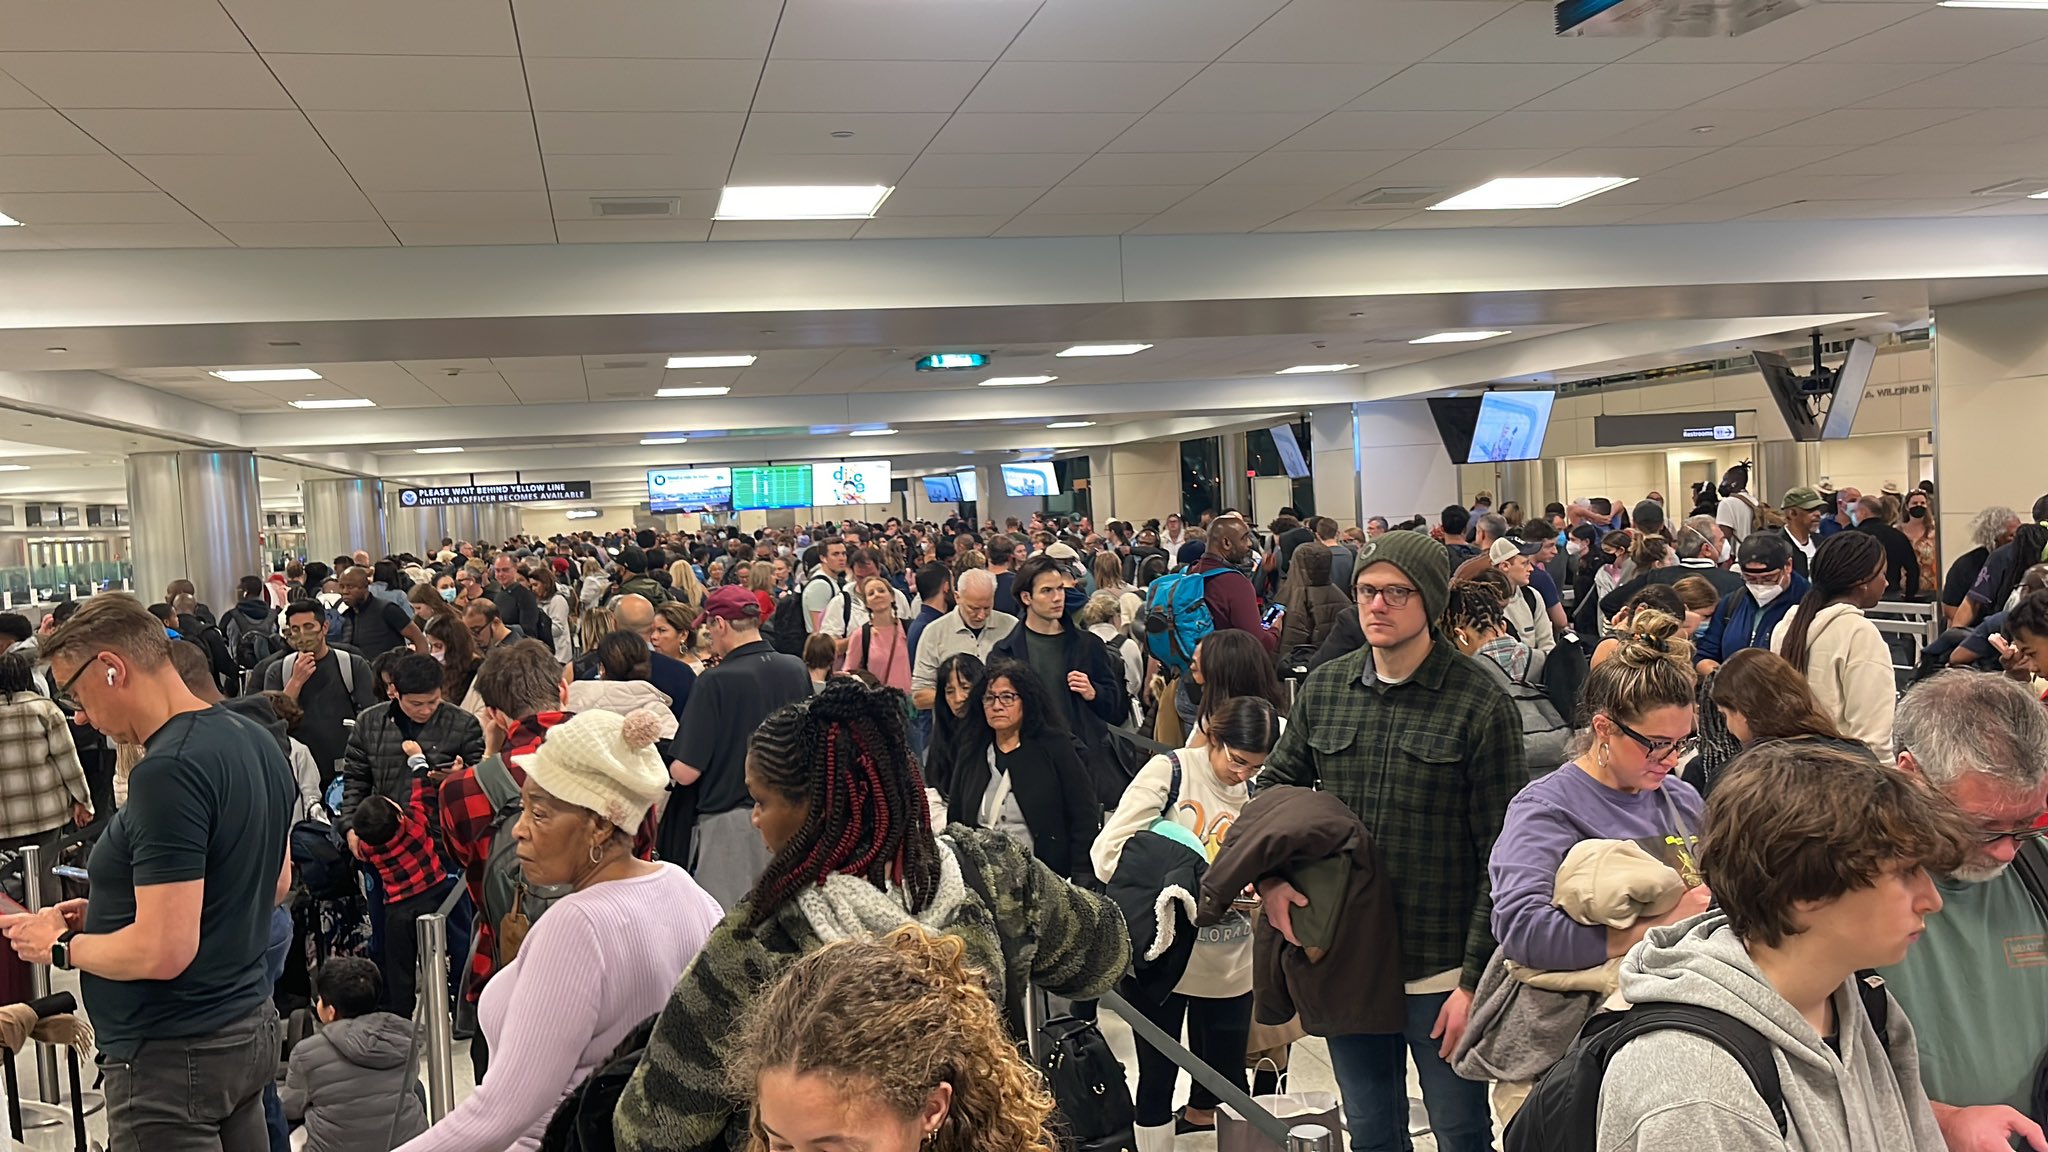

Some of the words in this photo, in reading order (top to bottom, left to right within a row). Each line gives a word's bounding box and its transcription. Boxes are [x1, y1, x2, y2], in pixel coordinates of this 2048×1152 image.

[419, 488, 450, 497] PLEASE
[452, 487, 474, 496] WAIT
[477, 485, 508, 495] BEHIND
[511, 484, 545, 493] YELLOW
[547, 483, 565, 491] LINE
[420, 497, 445, 505] UNTIL
[447, 496, 459, 504] AN
[462, 495, 495, 503] OFFICER
[498, 493, 538, 501] BECOMES
[541, 491, 584, 499] AVAILABLE
